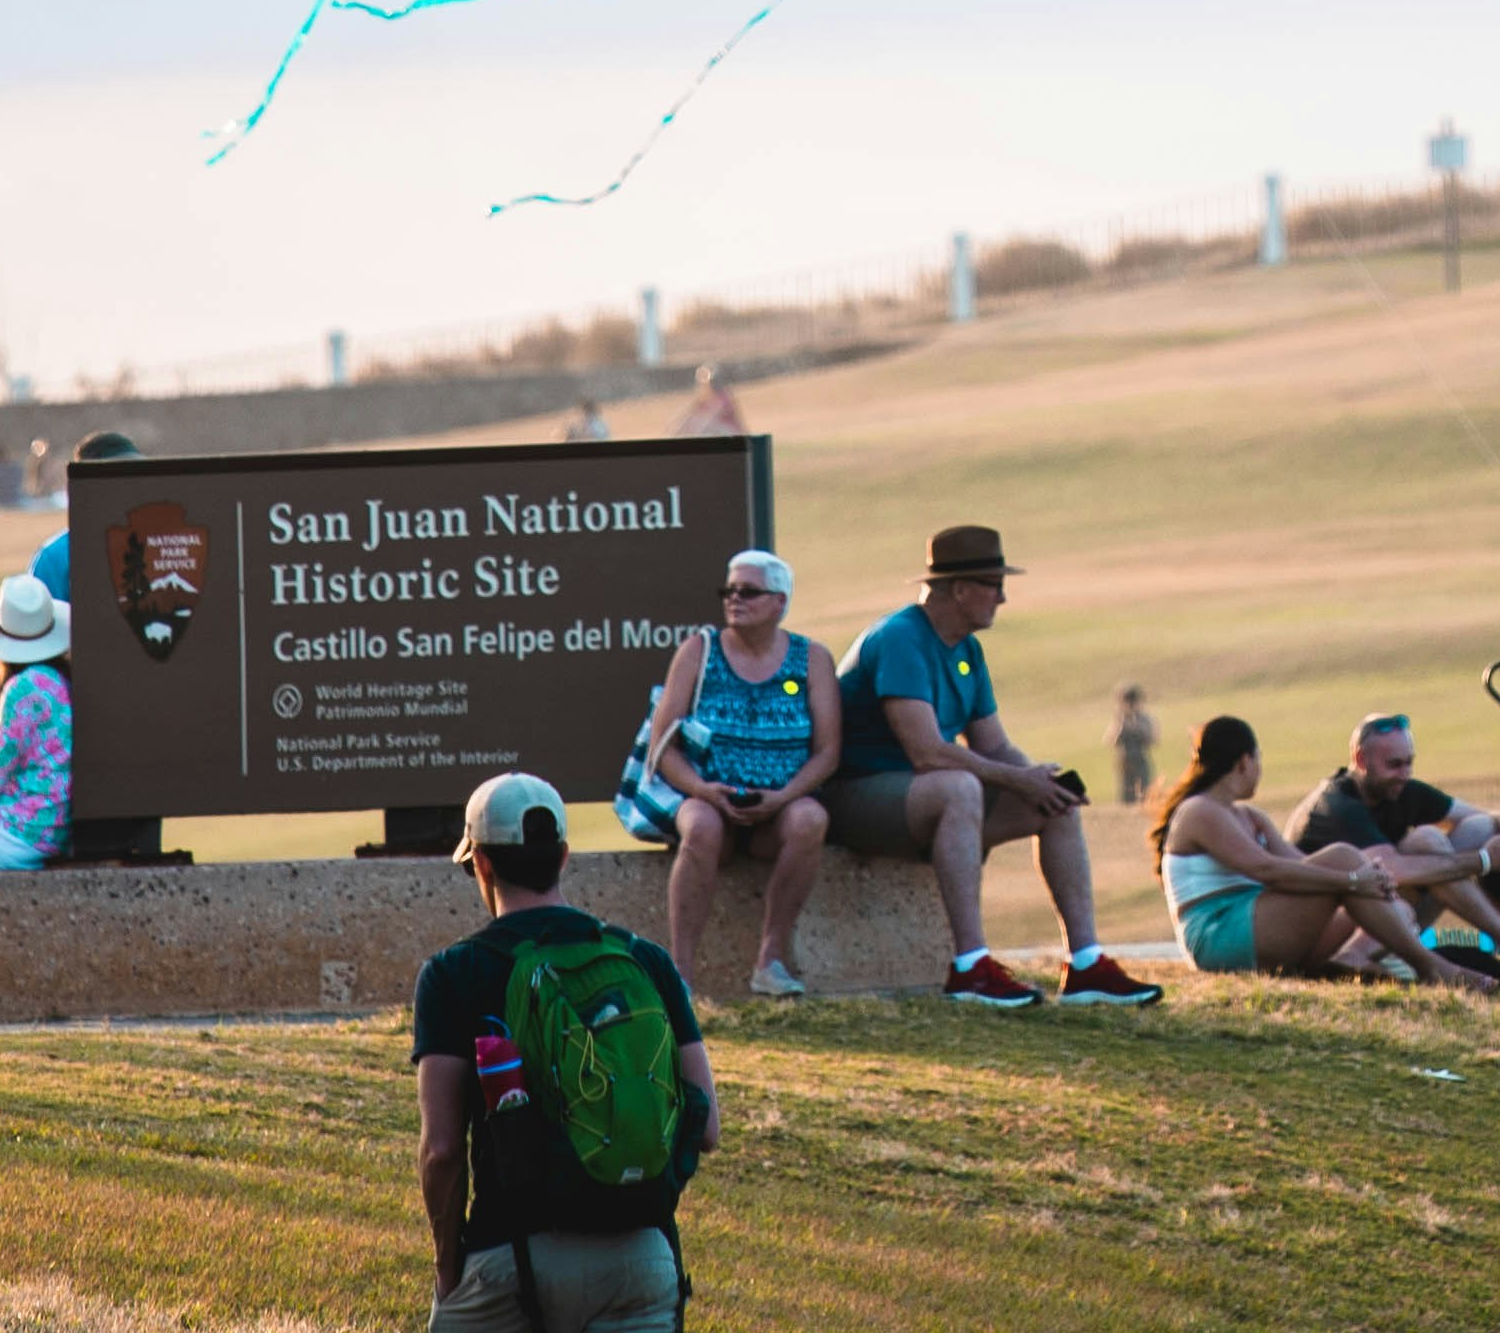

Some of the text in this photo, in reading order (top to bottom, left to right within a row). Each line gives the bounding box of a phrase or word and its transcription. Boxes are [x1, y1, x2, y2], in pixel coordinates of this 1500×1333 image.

[268, 485, 684, 551] San Juan National
[146, 534, 202, 547] NATIONAL
[160, 547, 189, 558] PARK
[152, 558, 197, 571] SERVICE
[270, 555, 560, 605] Historic Site
[273, 626, 388, 662] Castillo
[397, 626, 454, 659] San
[463, 622, 555, 661] Felipe
[564, 618, 611, 652] del
[315, 679, 469, 701] World Heritage Site
[315, 698, 469, 720] Patrimonio Mundial
[276, 731, 441, 752] National Park Service
[276, 748, 519, 772] U.S. Department of the Interior
